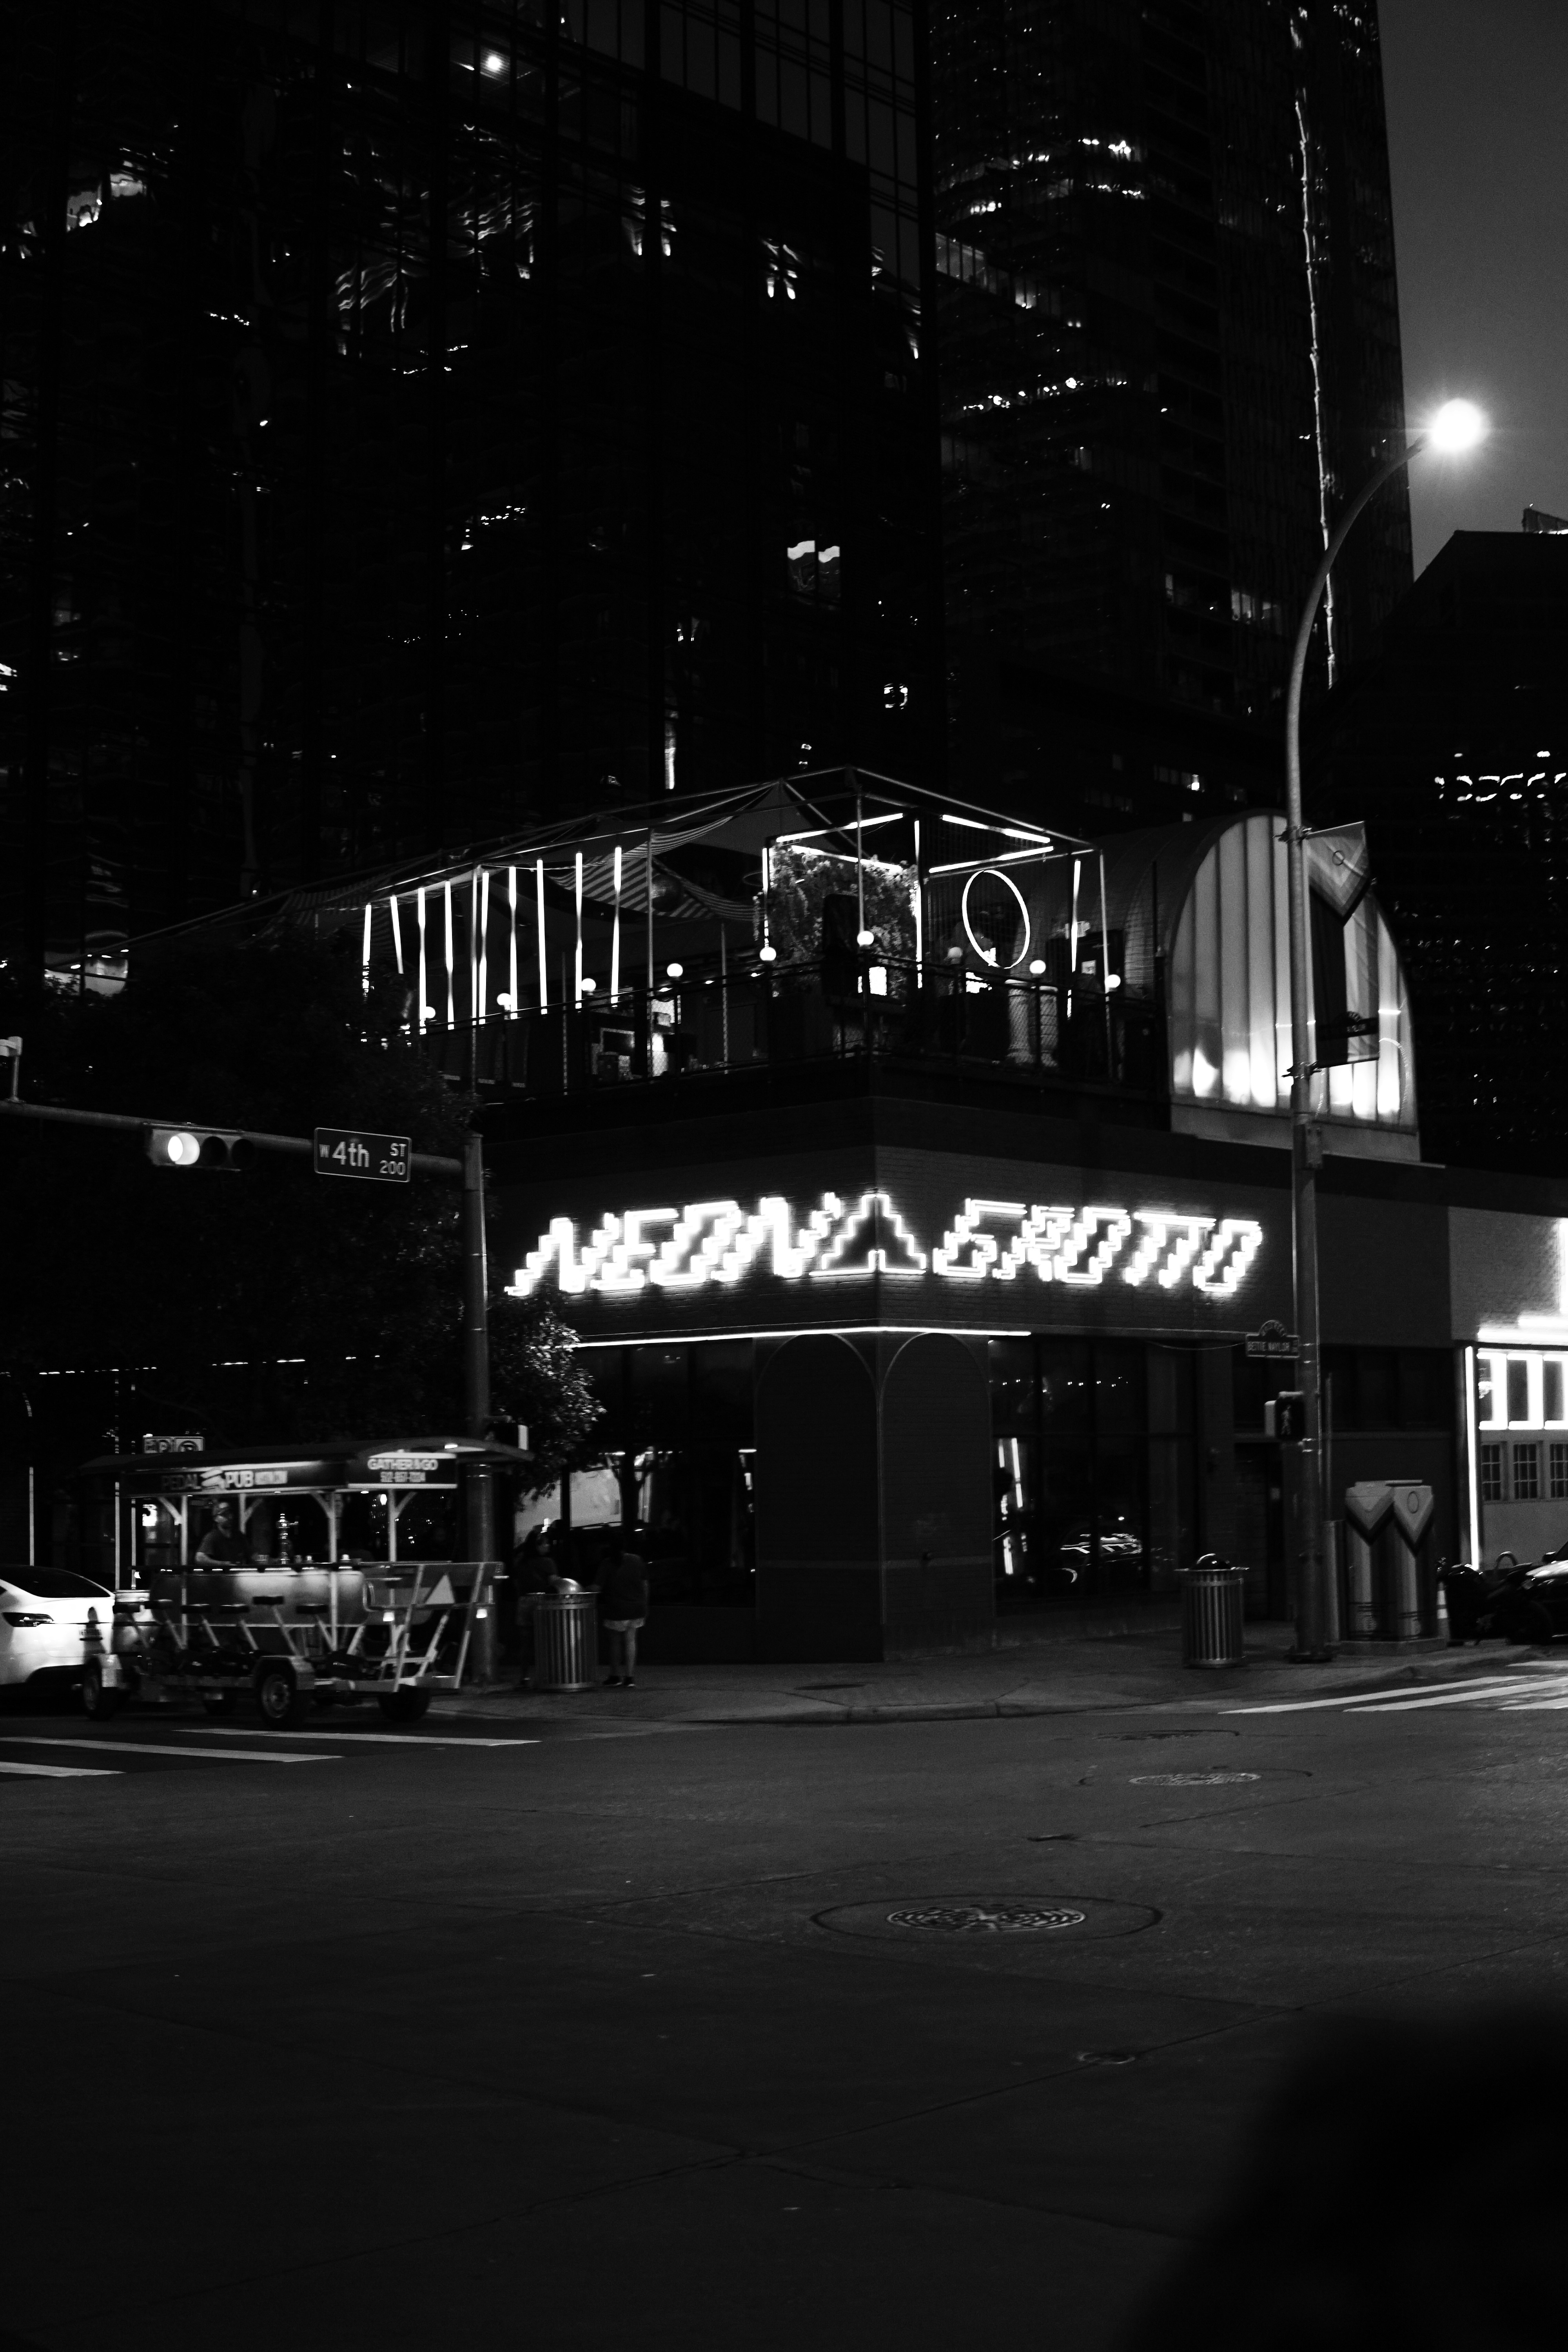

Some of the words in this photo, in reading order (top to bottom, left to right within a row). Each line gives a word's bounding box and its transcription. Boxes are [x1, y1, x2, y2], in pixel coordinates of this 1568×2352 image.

[319, 1144, 330, 1158] W
[332, 1142, 370, 1167] 4th
[390, 1143, 407, 1156] ST
[379, 1160, 406, 1175] 200
[224, 1471, 254, 1488] PUB
